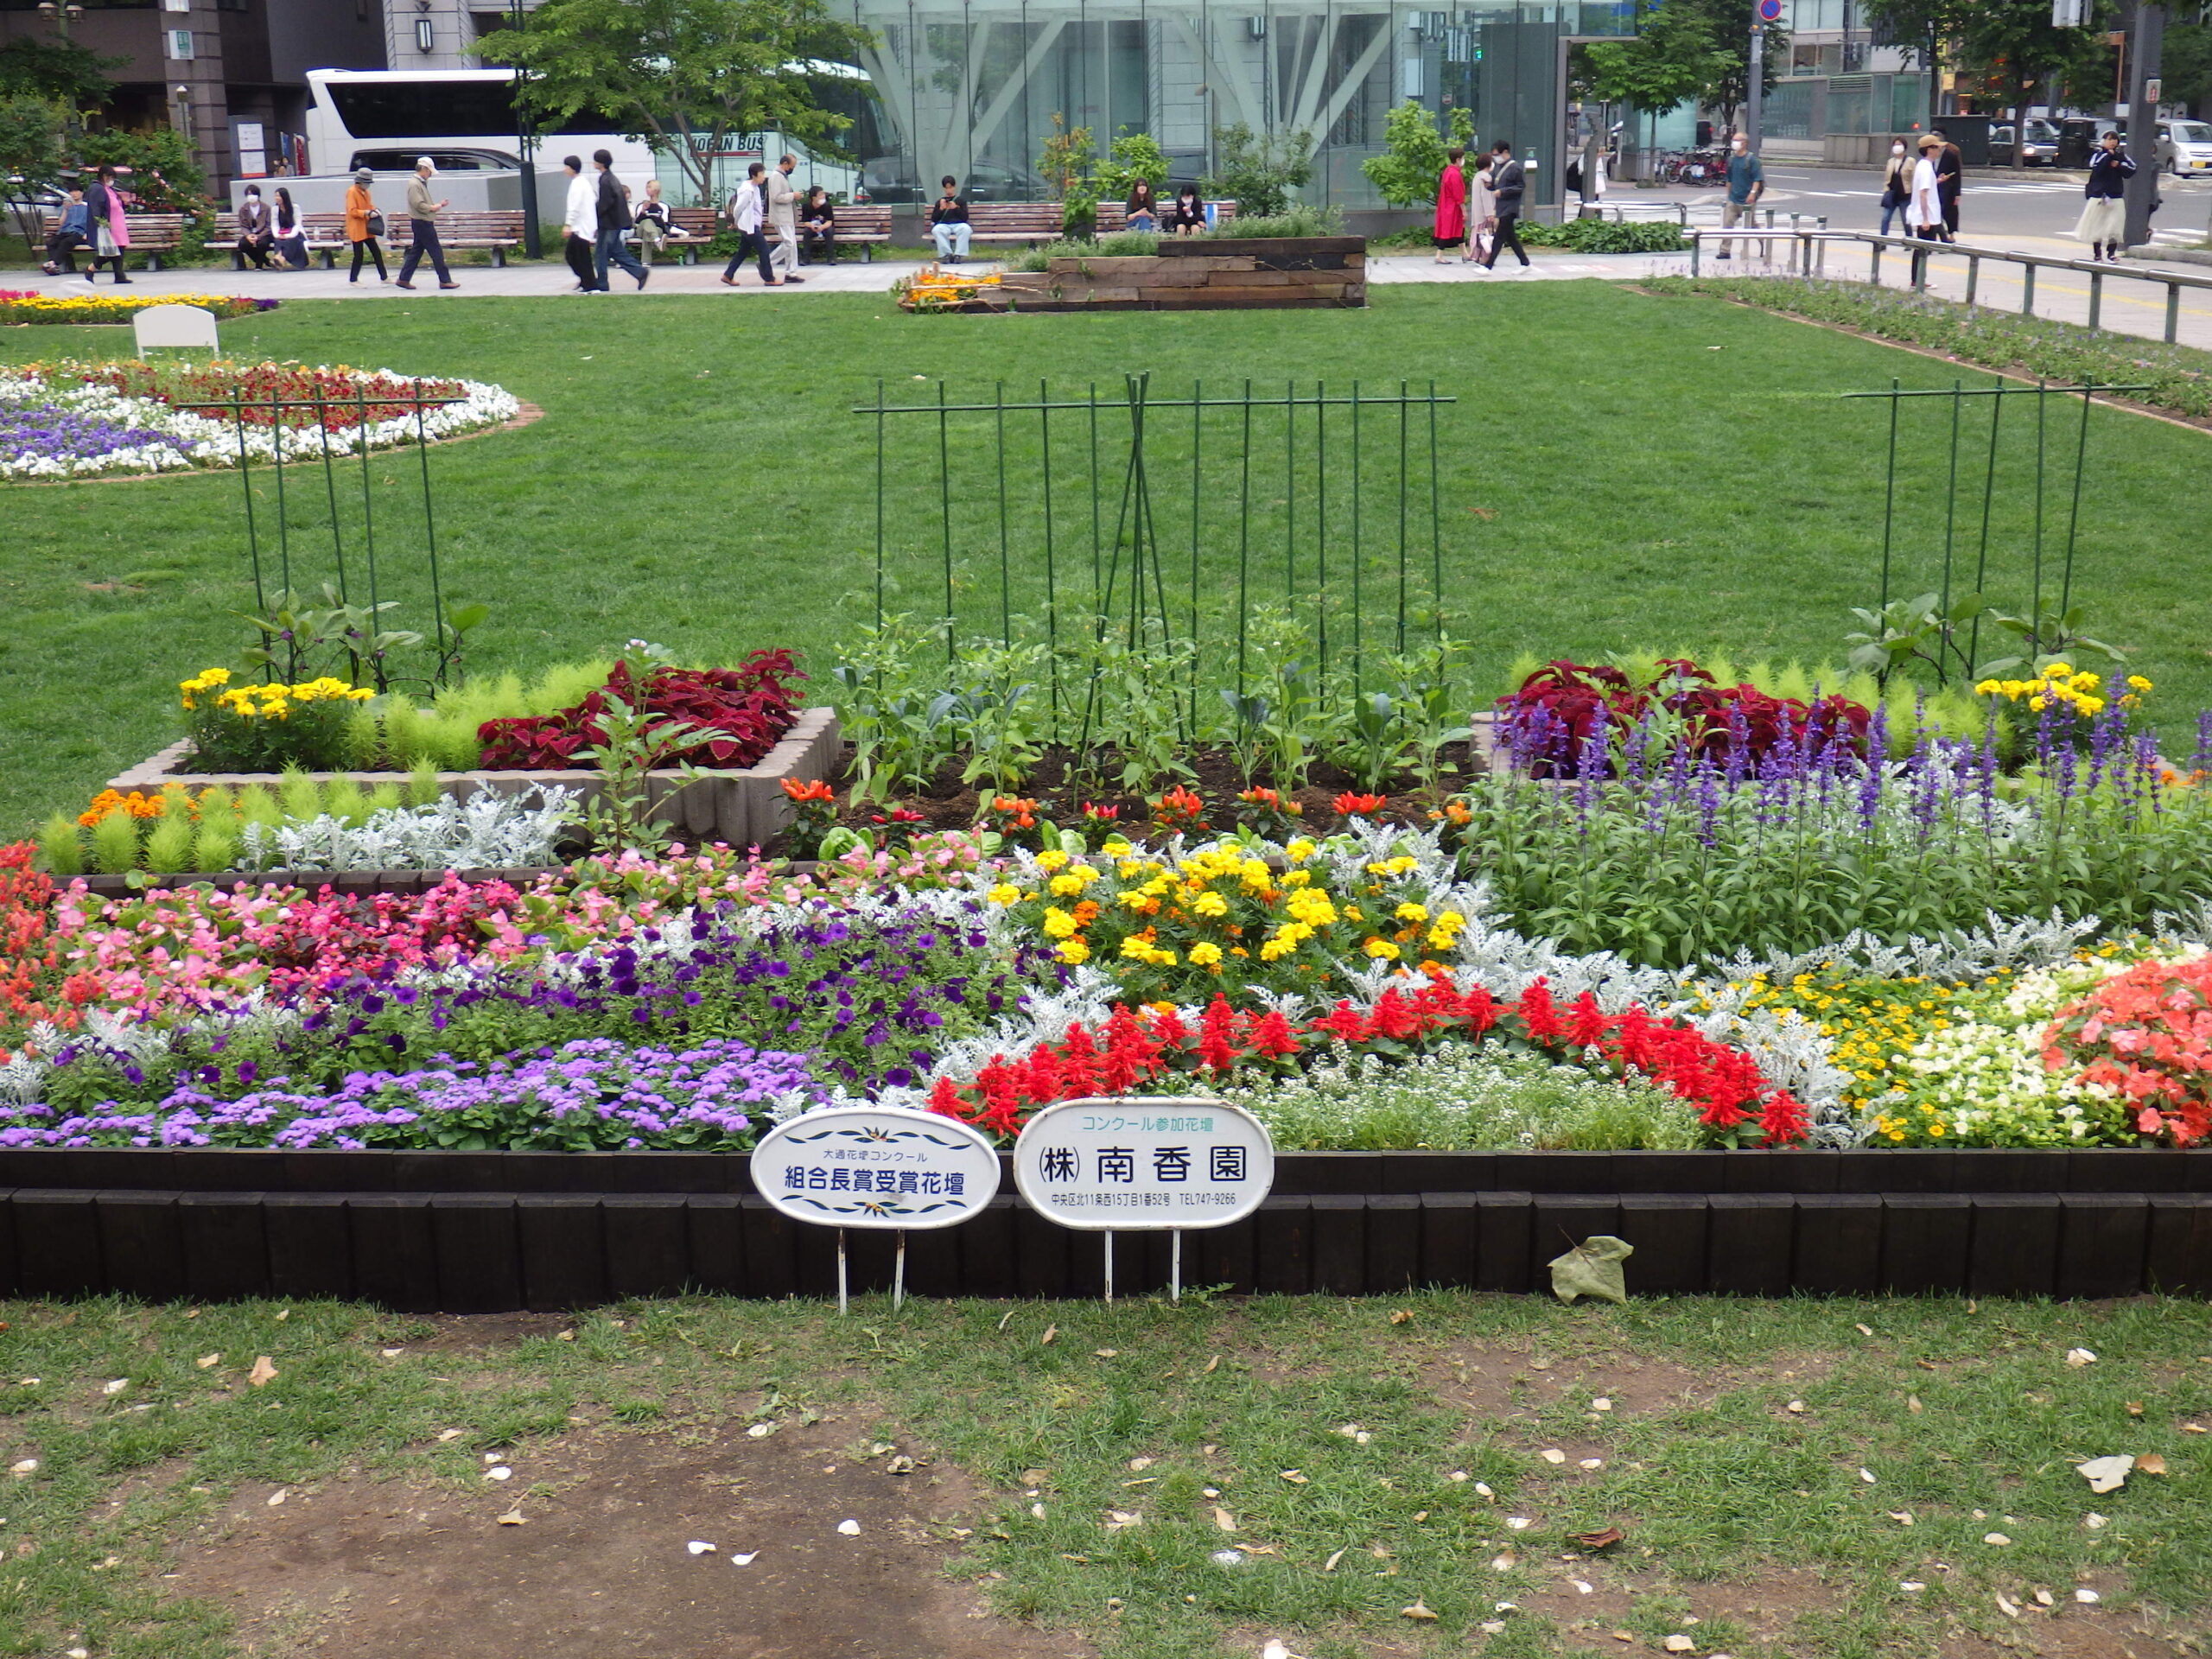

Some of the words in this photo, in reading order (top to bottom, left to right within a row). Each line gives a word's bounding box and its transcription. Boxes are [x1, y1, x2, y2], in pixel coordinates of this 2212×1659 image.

[737, 136, 763, 150] BUS
[1083, 1116, 1214, 1132] コンクール参加花壇
[785, 1165, 965, 1196] 組合長賞受賞花壇
[1179, 1192, 1236, 1205] TEL747-9266
